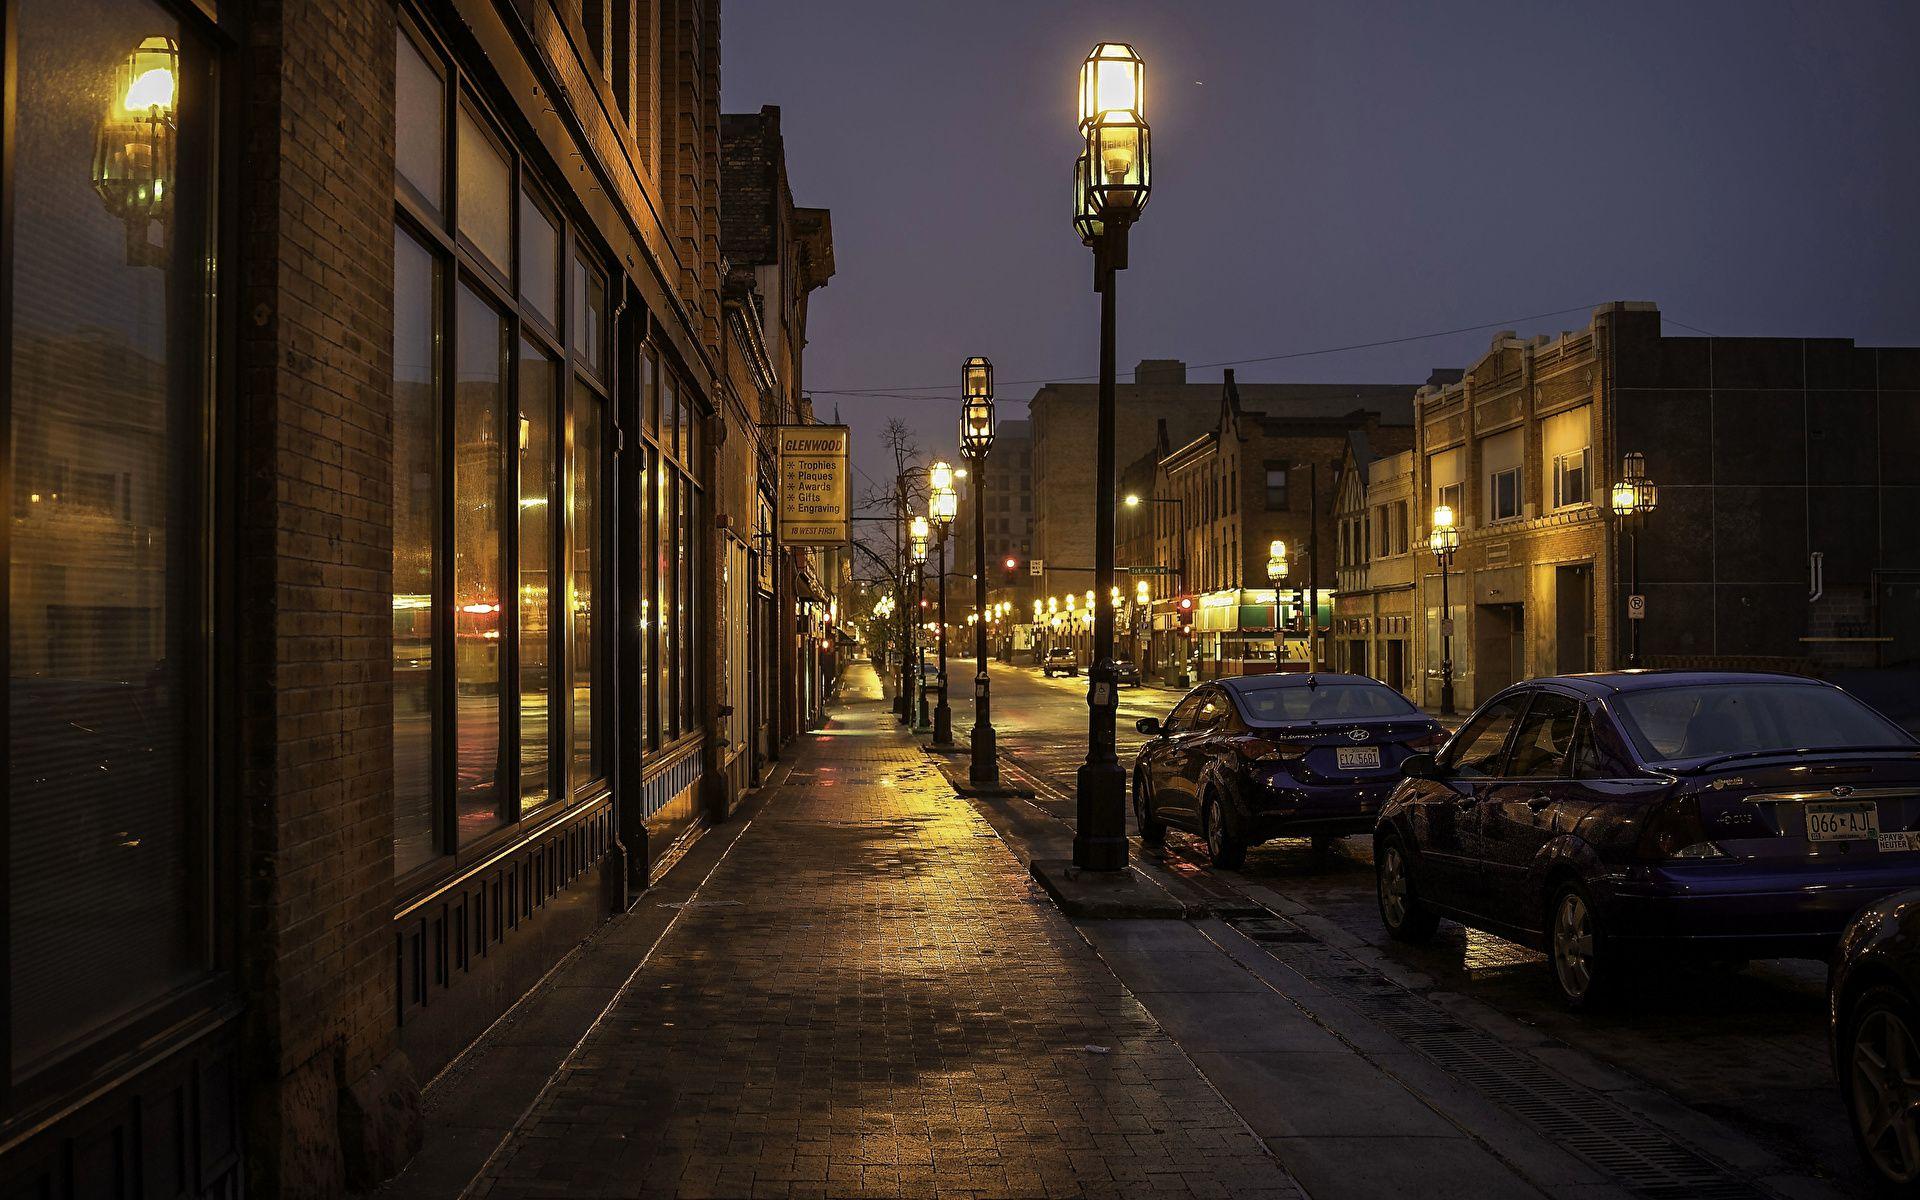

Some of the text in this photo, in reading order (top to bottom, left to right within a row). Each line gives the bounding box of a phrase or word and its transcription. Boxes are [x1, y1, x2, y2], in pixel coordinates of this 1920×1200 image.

[785, 440, 842, 452] GLENWOOD
[798, 461, 837, 471] Trophies
[798, 472, 833, 482] Plaques
[798, 482, 831, 491] Awards
[798, 493, 821, 502] Gifts
[798, 504, 840, 514] Engraving
[800, 527, 817, 535] WEST
[818, 527, 836, 535] FIRST
[1811, 812, 1874, 833] 066 AJL
[1879, 833, 1897, 841] SPAY
[1879, 841, 1907, 849] NEUTER
